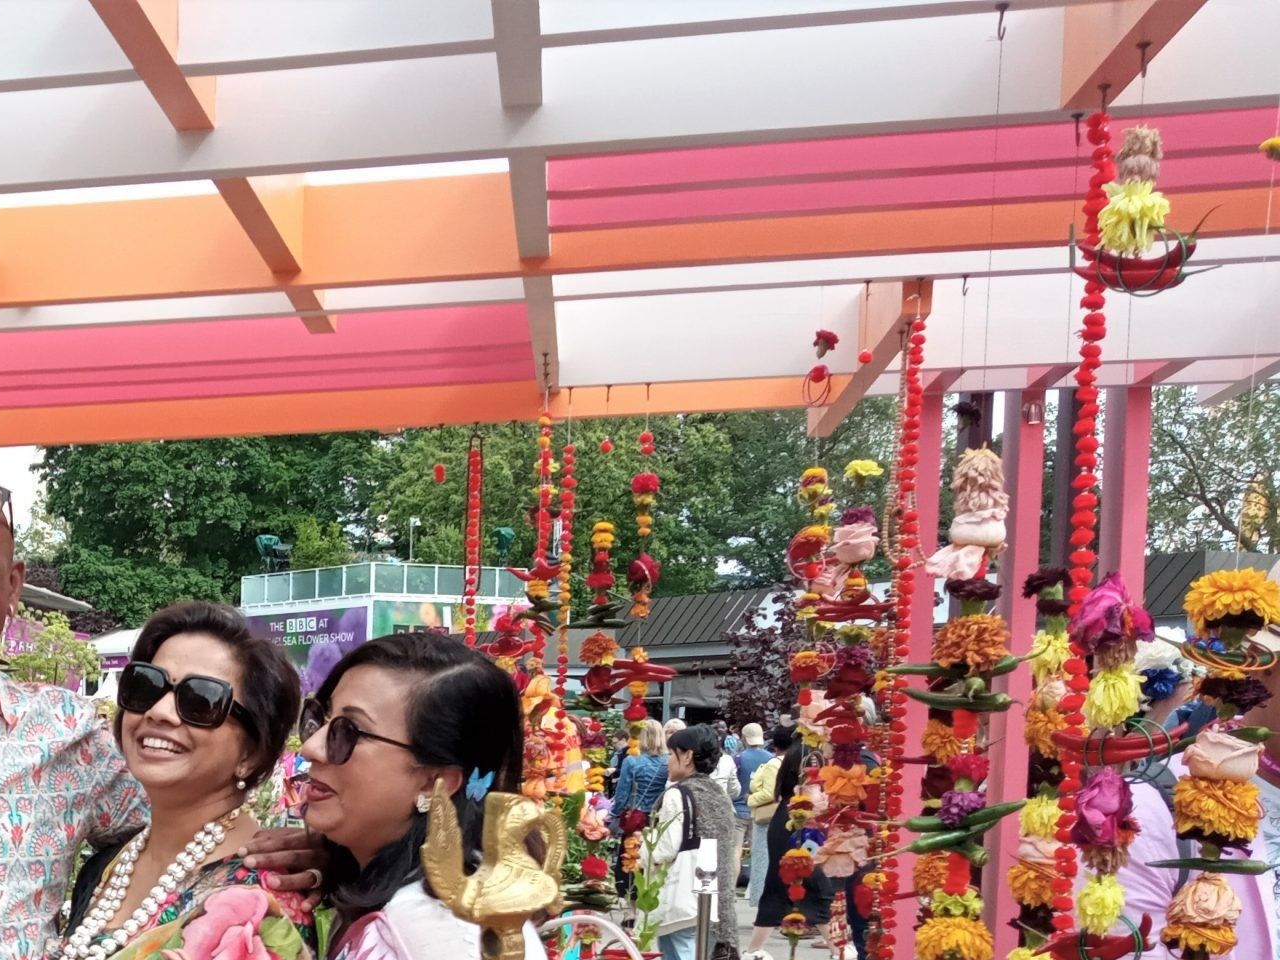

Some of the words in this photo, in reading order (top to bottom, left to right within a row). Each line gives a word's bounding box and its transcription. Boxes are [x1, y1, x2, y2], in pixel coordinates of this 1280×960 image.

[269, 622, 284, 632] THE
[287, 618, 316, 632] BBC
[318, 618, 329, 629] AT
[298, 633, 329, 645] FLOWER
[330, 632, 354, 643] SHOW
